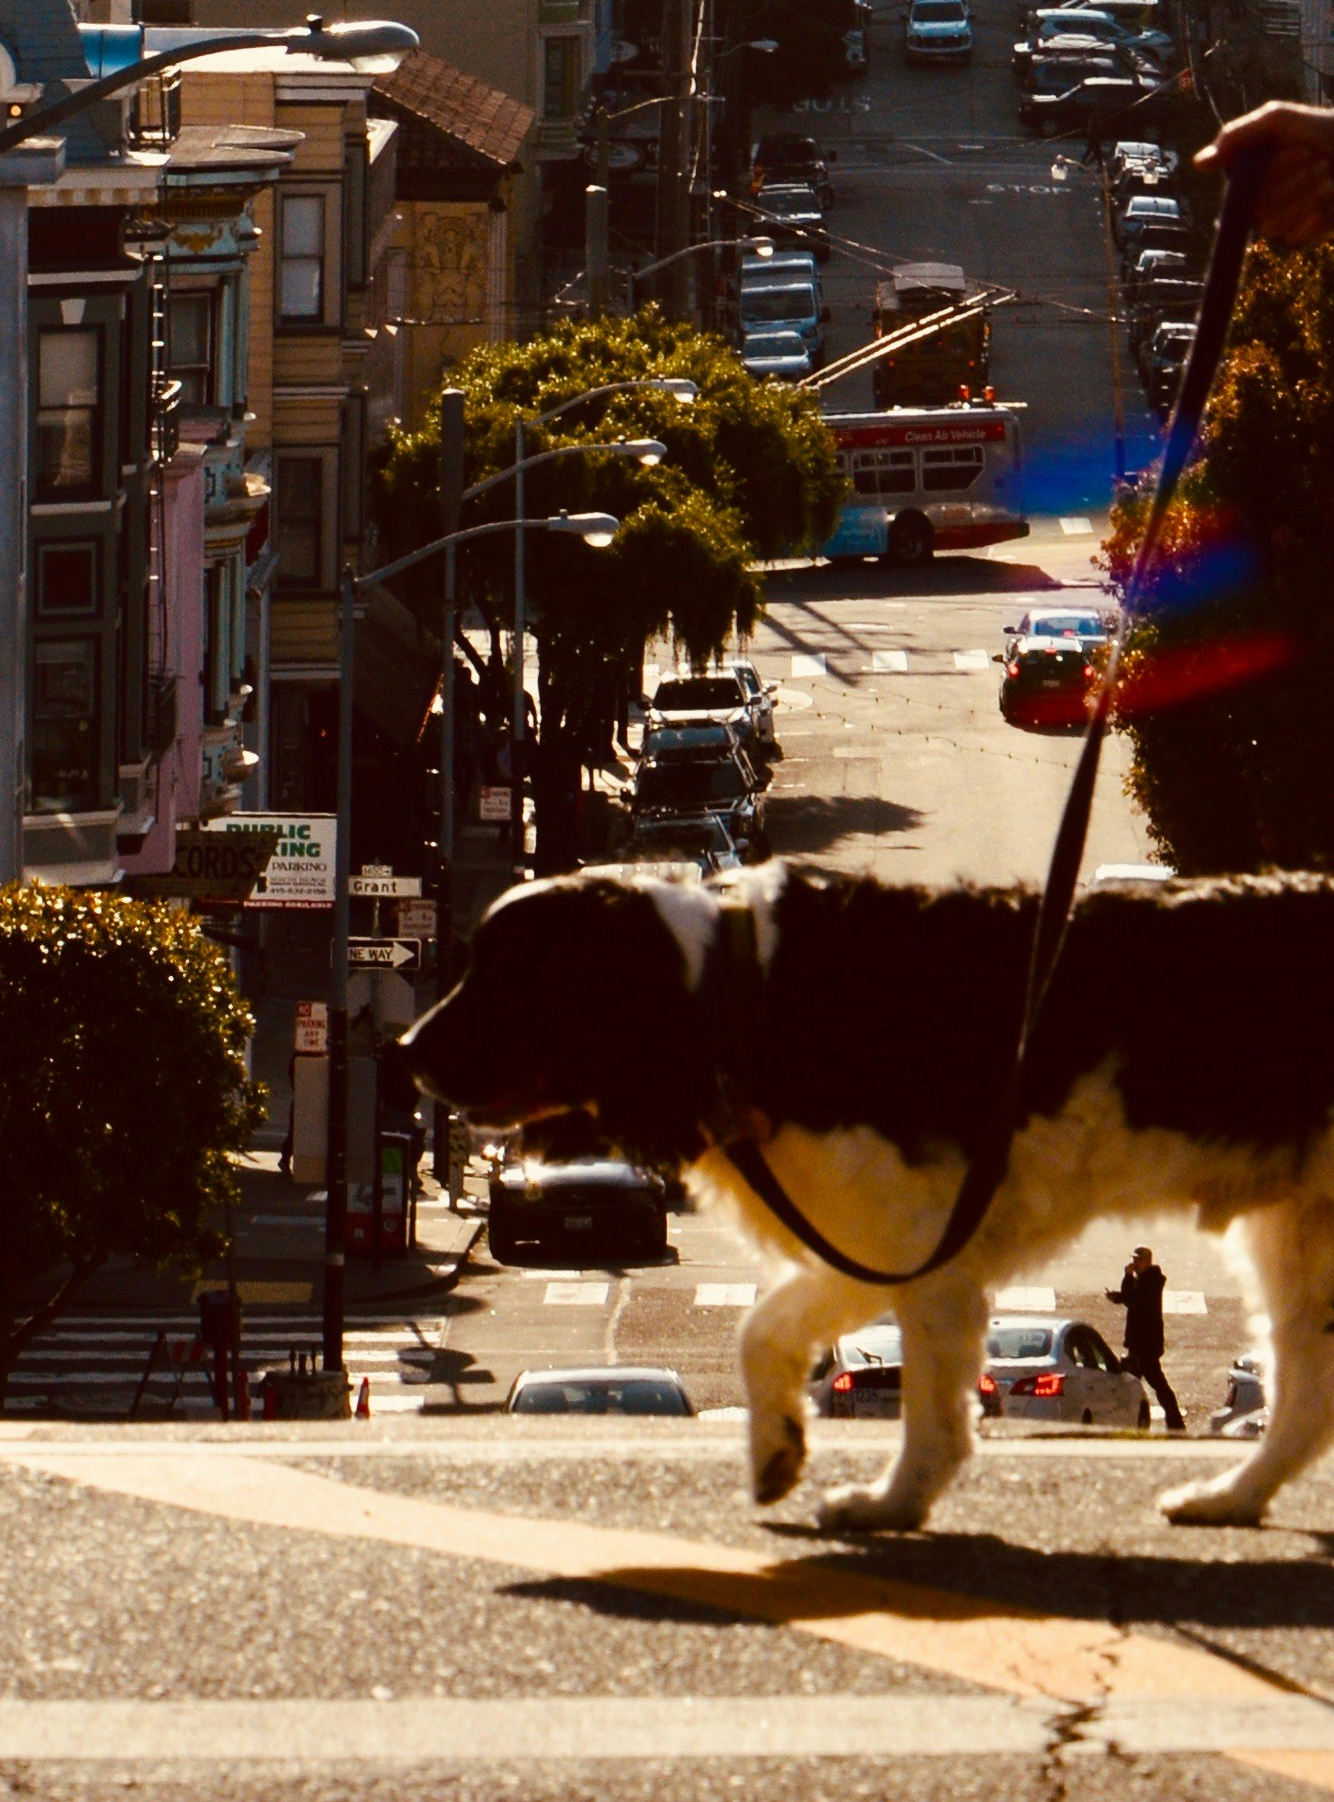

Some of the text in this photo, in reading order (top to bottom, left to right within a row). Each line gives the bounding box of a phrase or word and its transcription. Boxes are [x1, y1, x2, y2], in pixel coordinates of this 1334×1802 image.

[905, 428, 986, 442] Clean Air Vehicle
[276, 842, 321, 857] ING
[271, 861, 327, 873] PARKING
[353, 881, 397, 893] Grant
[348, 948, 393, 960] NE WAY
